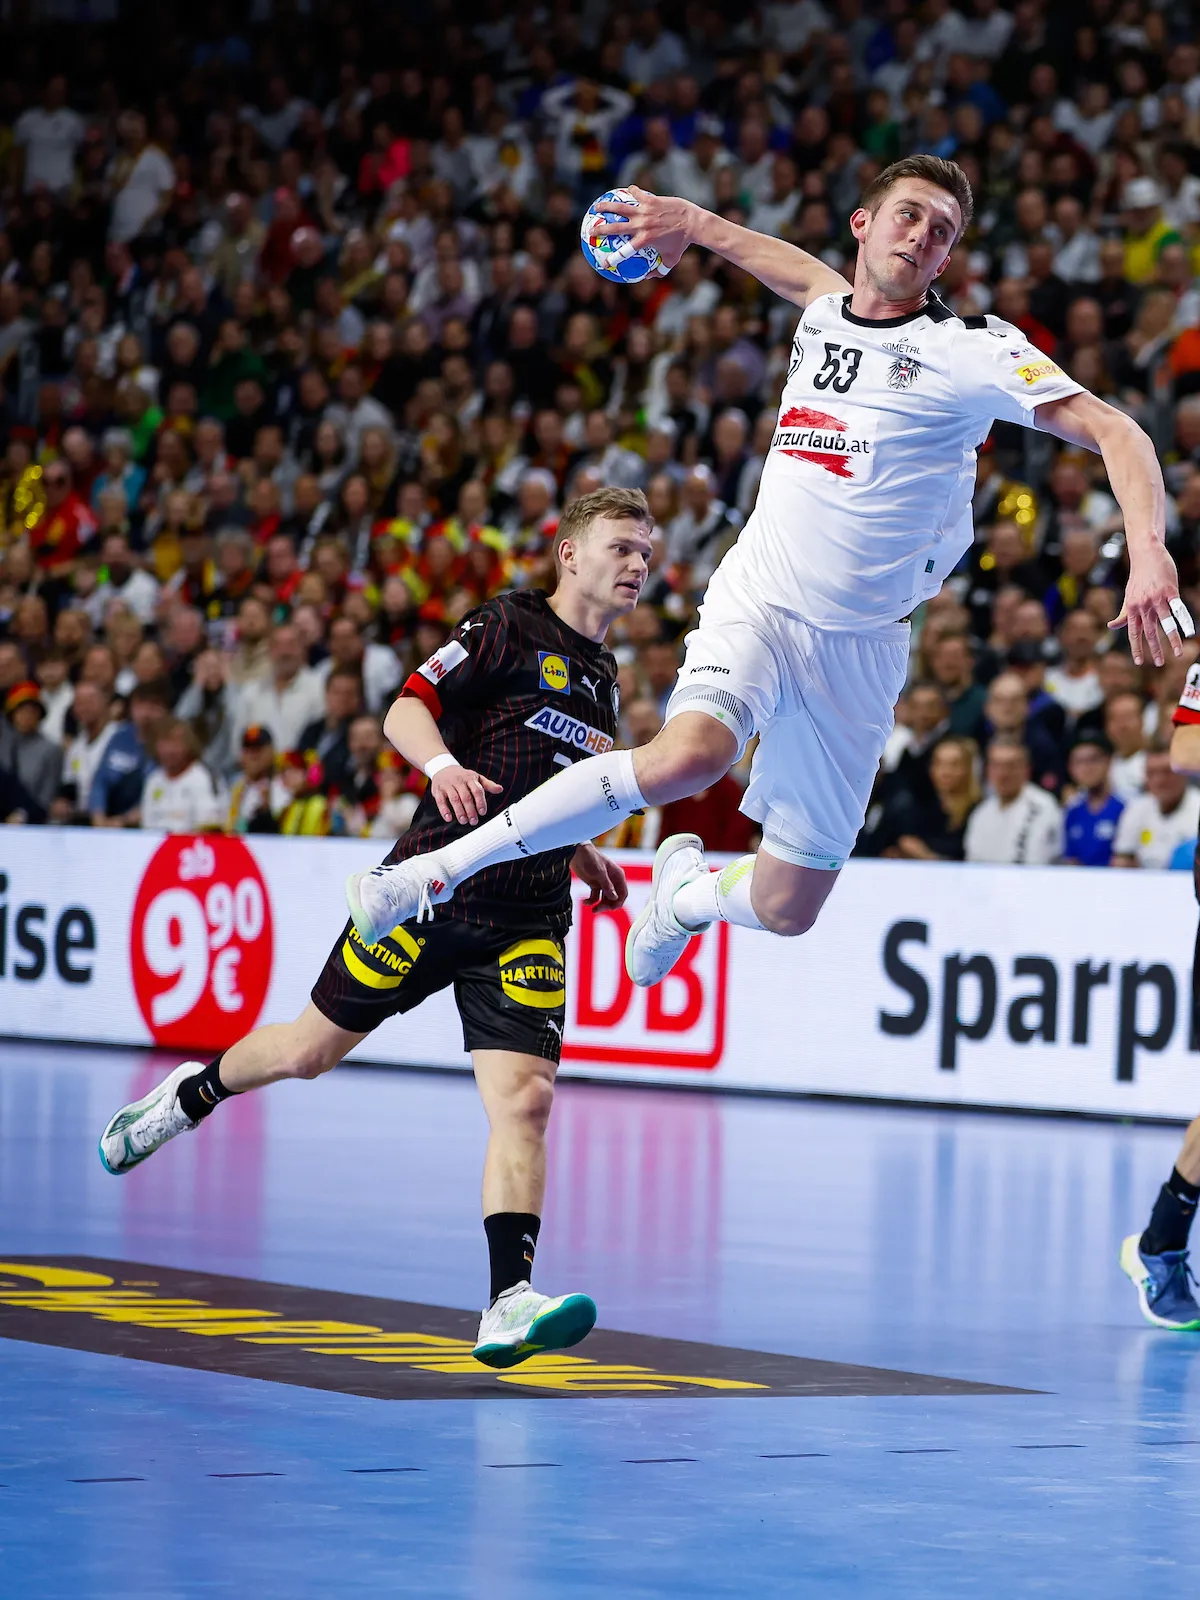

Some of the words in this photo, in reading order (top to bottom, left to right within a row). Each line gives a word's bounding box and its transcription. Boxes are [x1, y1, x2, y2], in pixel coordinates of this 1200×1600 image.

[881, 342, 921, 355] SOMETAL
[813, 342, 863, 394] 53
[1022, 364, 1062, 382] Joser
[773, 430, 870, 454] urzurlaub.at
[690, 665, 731, 675] Kempa
[600, 775, 620, 812] SELECT
[178, 838, 216, 880] ab
[501, 965, 565, 985] HARTING
[576, 896, 704, 1035] DB
